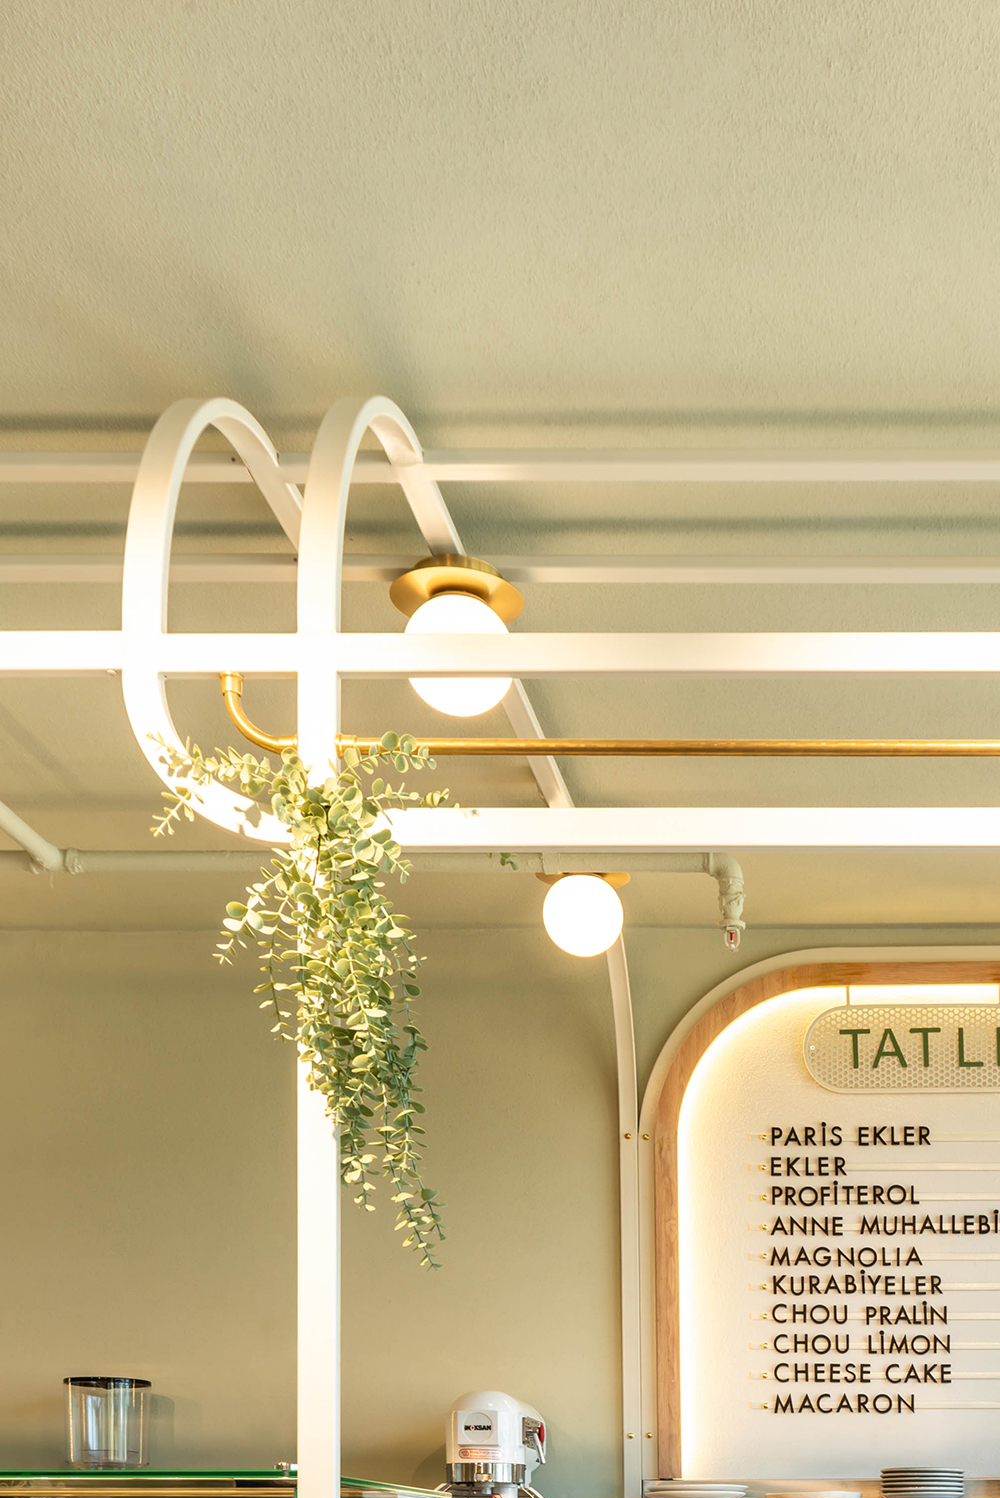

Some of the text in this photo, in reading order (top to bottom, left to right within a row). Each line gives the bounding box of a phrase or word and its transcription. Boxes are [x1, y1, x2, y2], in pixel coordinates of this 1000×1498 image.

[858, 1126, 931, 1147] EKLER
[770, 1156, 847, 1177] EKLER
[770, 1216, 844, 1236] ANNE
[770, 1246, 923, 1268] MAGNOLIA
[772, 1303, 848, 1325] CHOU
[773, 1333, 850, 1355] CHOU
[774, 1362, 952, 1384] CHEESE CAKE
[774, 1393, 915, 1414] MACARON
